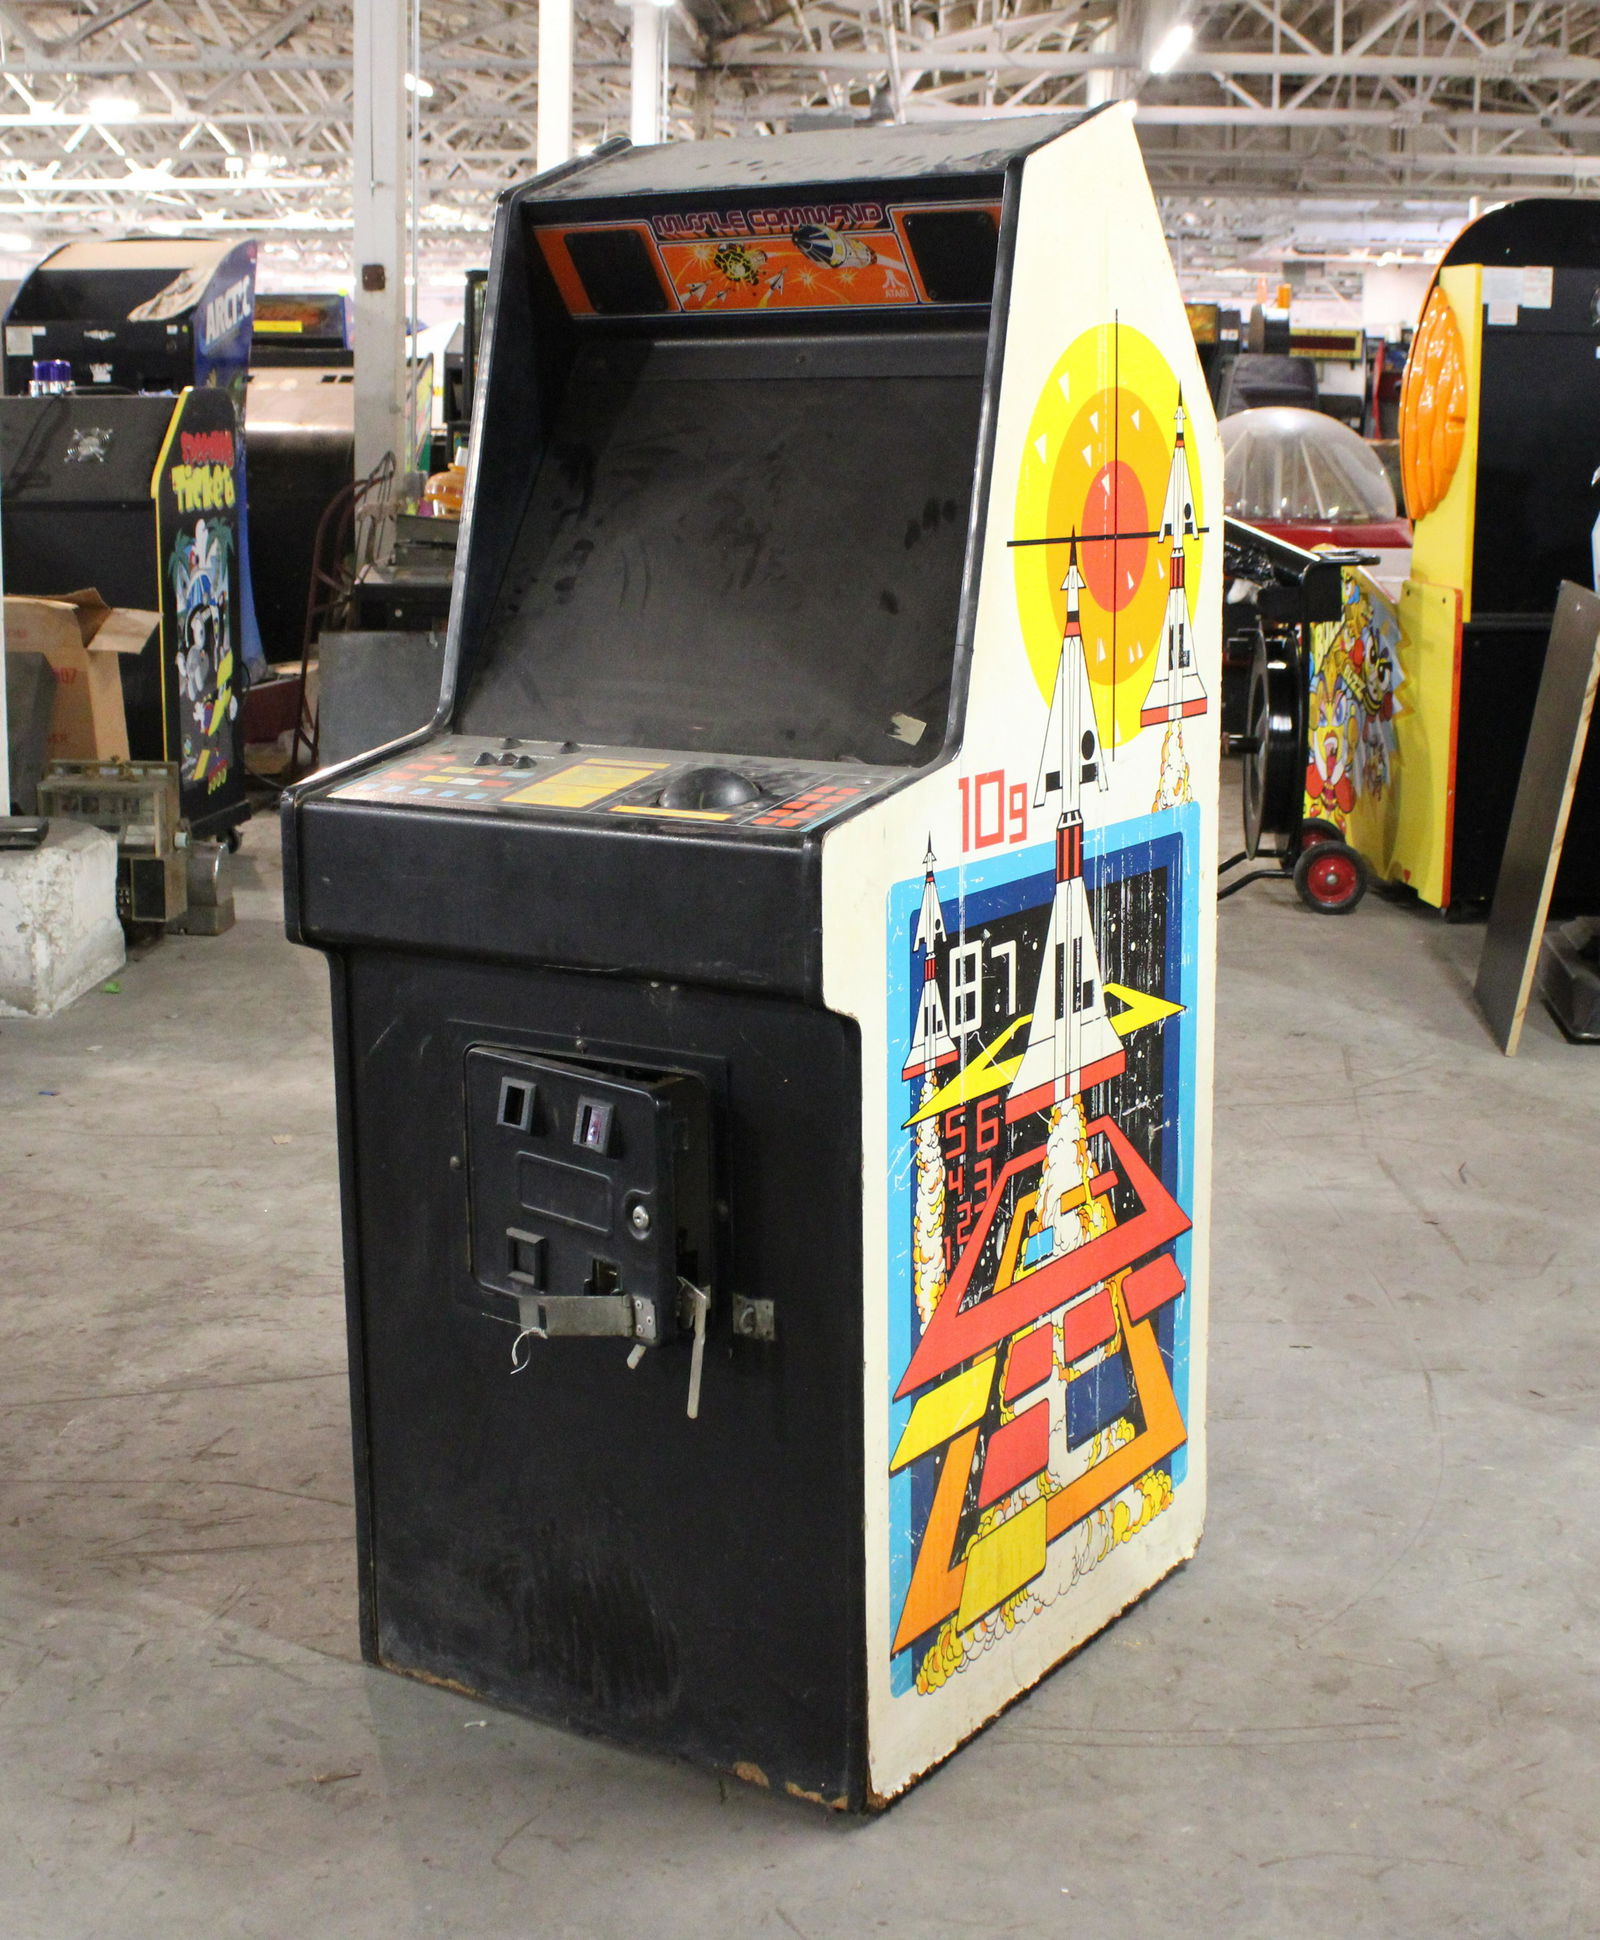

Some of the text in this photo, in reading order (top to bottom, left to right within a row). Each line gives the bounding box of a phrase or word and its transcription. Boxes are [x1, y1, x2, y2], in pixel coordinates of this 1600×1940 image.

[653, 202, 883, 236] MISSILE COMMAND
[884, 287, 910, 298] ATARI
